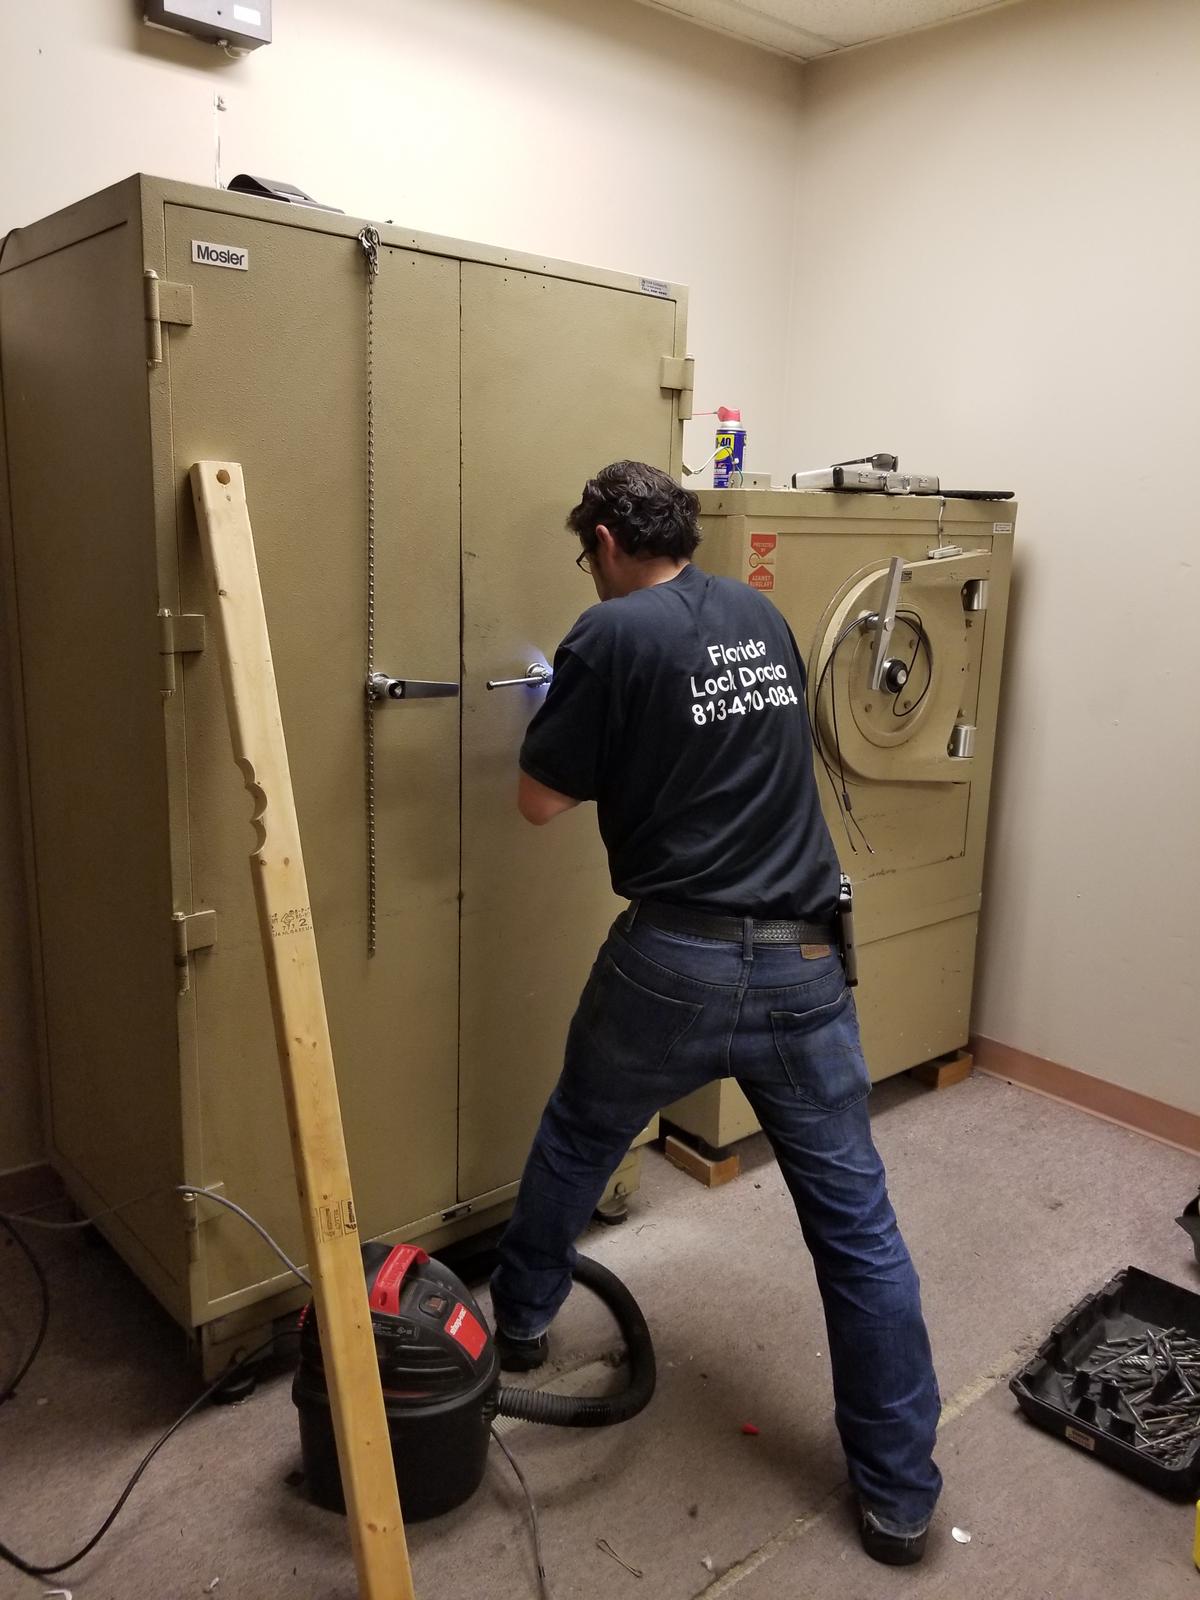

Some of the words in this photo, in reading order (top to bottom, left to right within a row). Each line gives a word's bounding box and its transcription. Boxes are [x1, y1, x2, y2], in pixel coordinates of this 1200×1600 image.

[197, 244, 245, 266] Mosler
[707, 639, 767, 666] Florida
[690, 670, 737, 698] Lock
